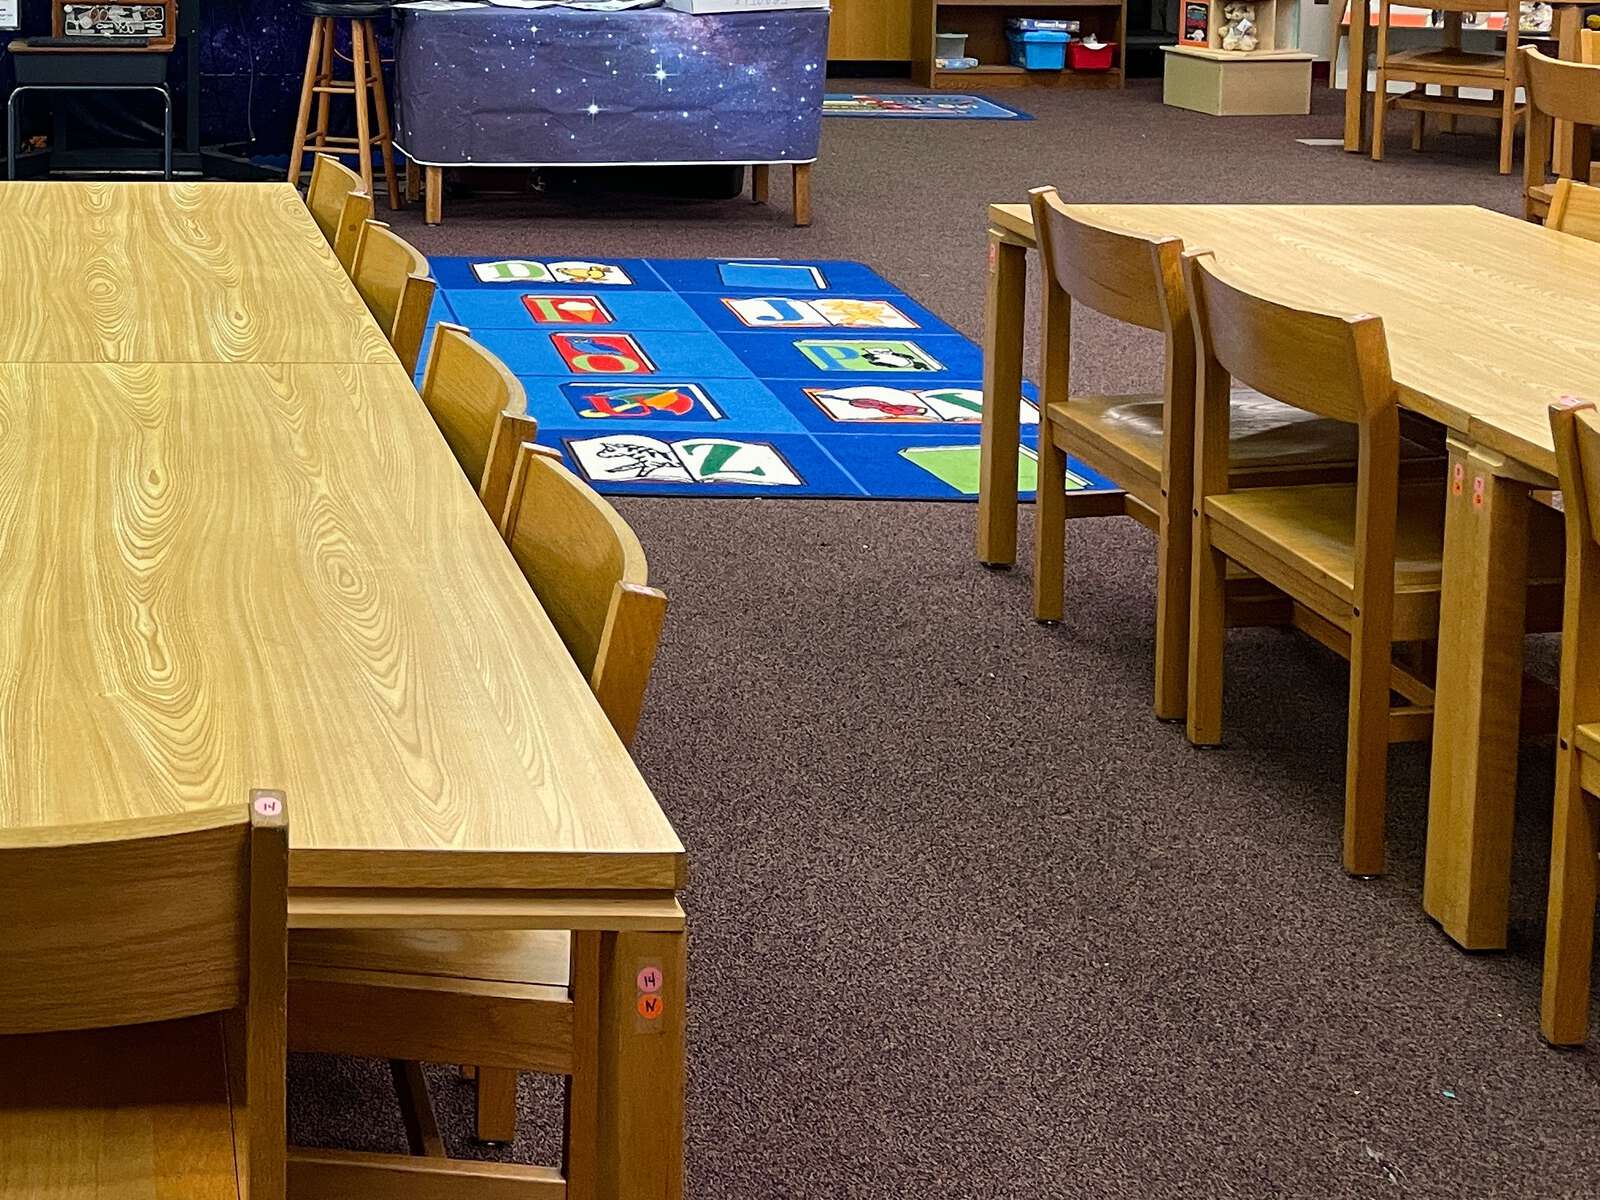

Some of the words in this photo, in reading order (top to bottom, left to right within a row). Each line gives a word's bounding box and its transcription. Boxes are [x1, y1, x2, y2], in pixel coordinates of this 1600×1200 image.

[488, 262, 545, 279] D
[756, 299, 804, 322] J
[807, 344, 860, 370] P
[682, 443, 766, 476] Z
[643, 971, 656, 988] 14
[645, 998, 657, 1012] N
